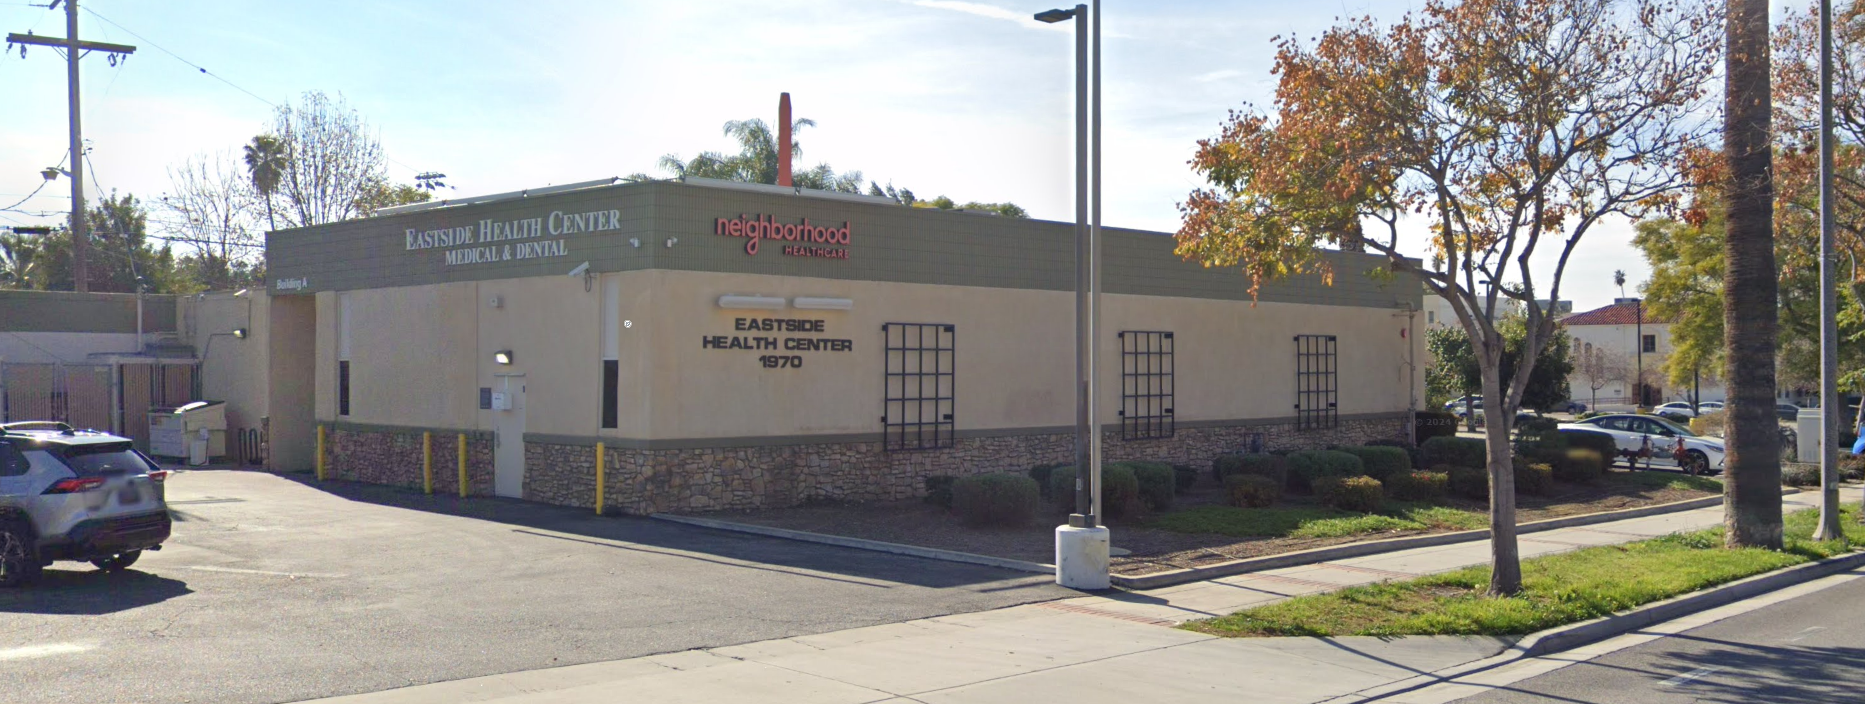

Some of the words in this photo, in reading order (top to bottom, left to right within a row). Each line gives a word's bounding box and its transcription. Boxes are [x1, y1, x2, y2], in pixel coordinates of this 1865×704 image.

[715, 213, 850, 256] neighborhood
[445, 249, 500, 266] MEDICAL
[502, 244, 512, 260] &
[516, 239, 568, 259] DENTAL
[783, 245, 850, 259] HEALTHCARE
[276, 278, 301, 291] Building
[302, 277, 307, 287] A
[735, 318, 825, 332] EASTSIDE
[702, 335, 778, 350] HEALTH
[784, 338, 853, 352] CENTER
[758, 355, 802, 369] 1970
